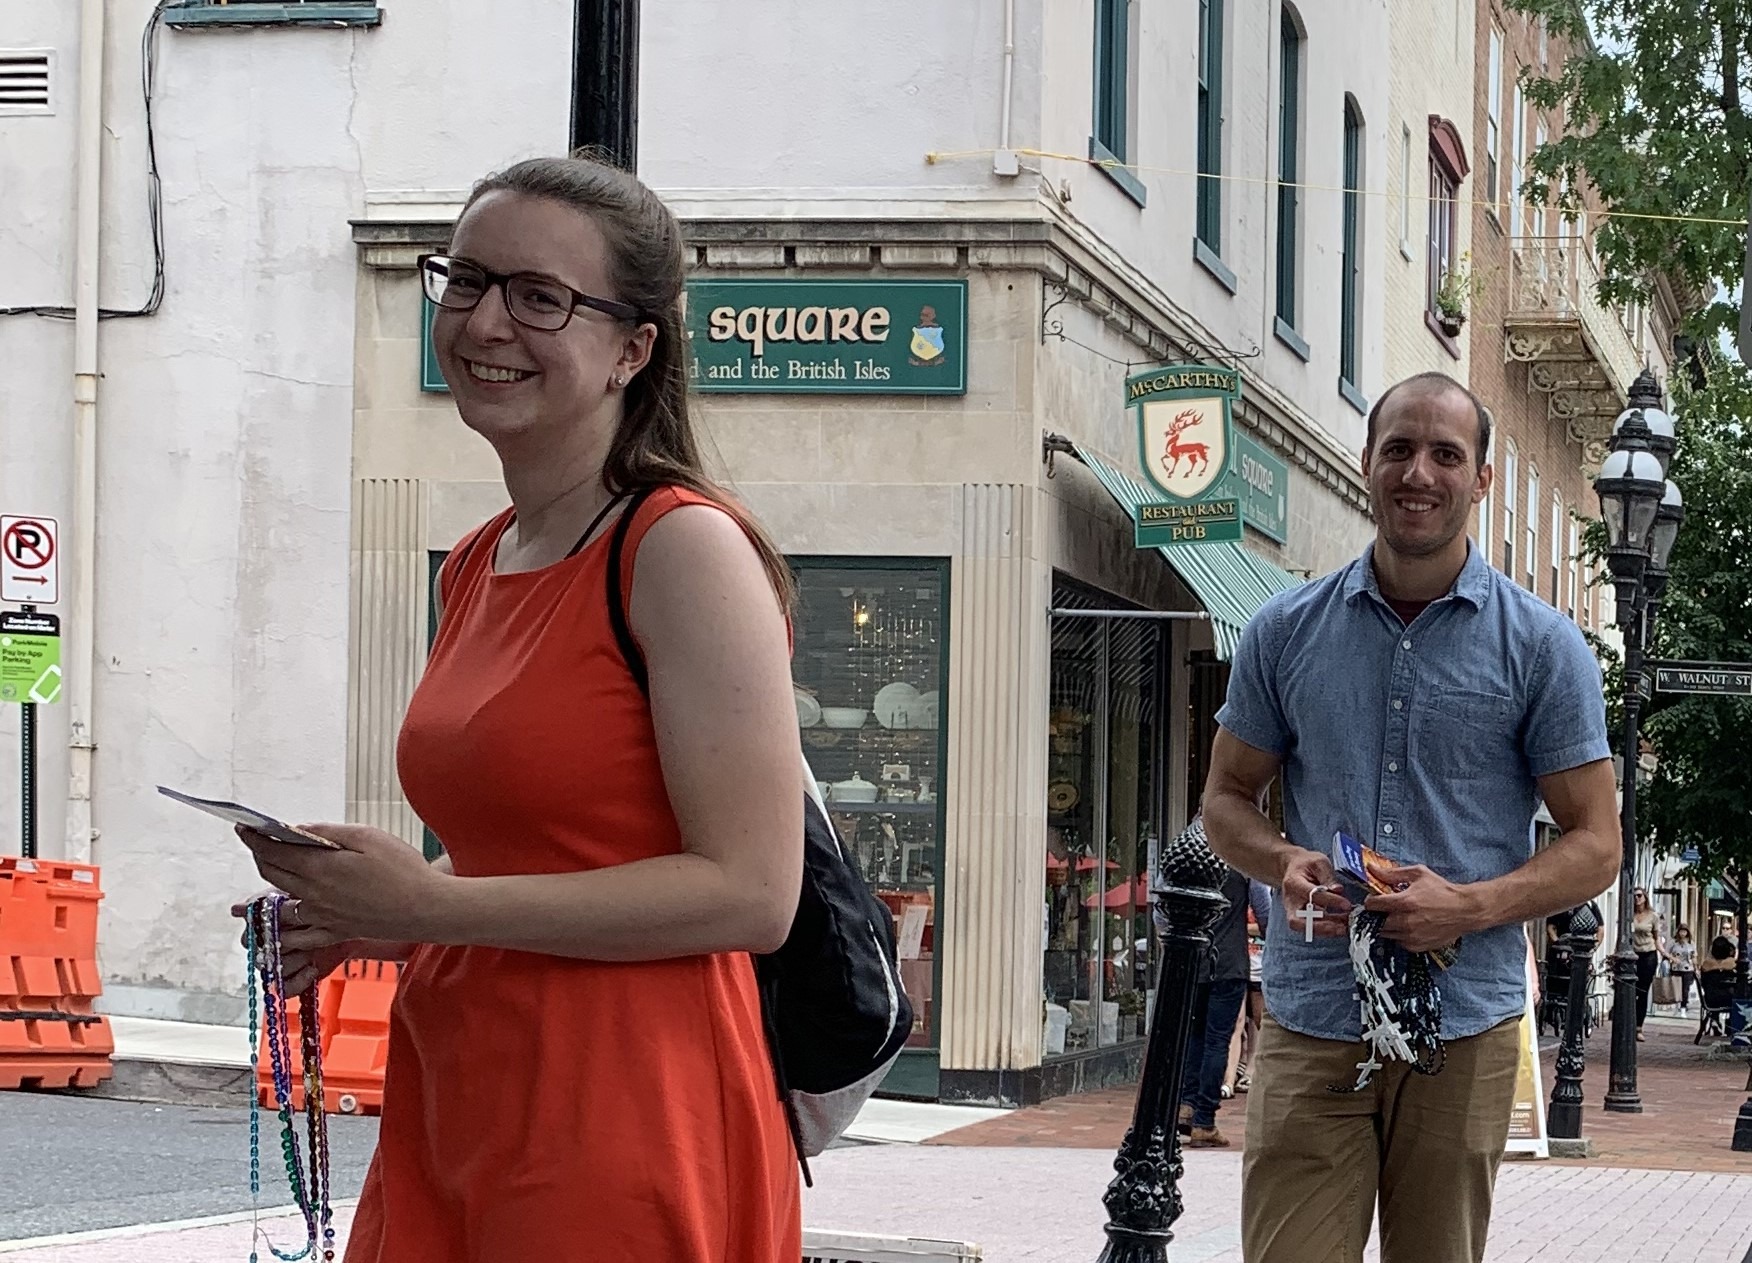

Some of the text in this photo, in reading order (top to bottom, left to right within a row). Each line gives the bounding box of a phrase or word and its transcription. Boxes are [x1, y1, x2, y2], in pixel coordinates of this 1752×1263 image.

[708, 357, 743, 379] and
[751, 357, 780, 379] the
[787, 357, 846, 380] British
[854, 358, 891, 380] Isles
[1141, 502, 1235, 520] RESTAURANT
[1172, 526, 1206, 540] PUB
[2, 648, 16, 656] Pay
[28, 650, 43, 658] App
[2, 655, 31, 664] Parking
[1679, 672, 1728, 685] WALNUT
